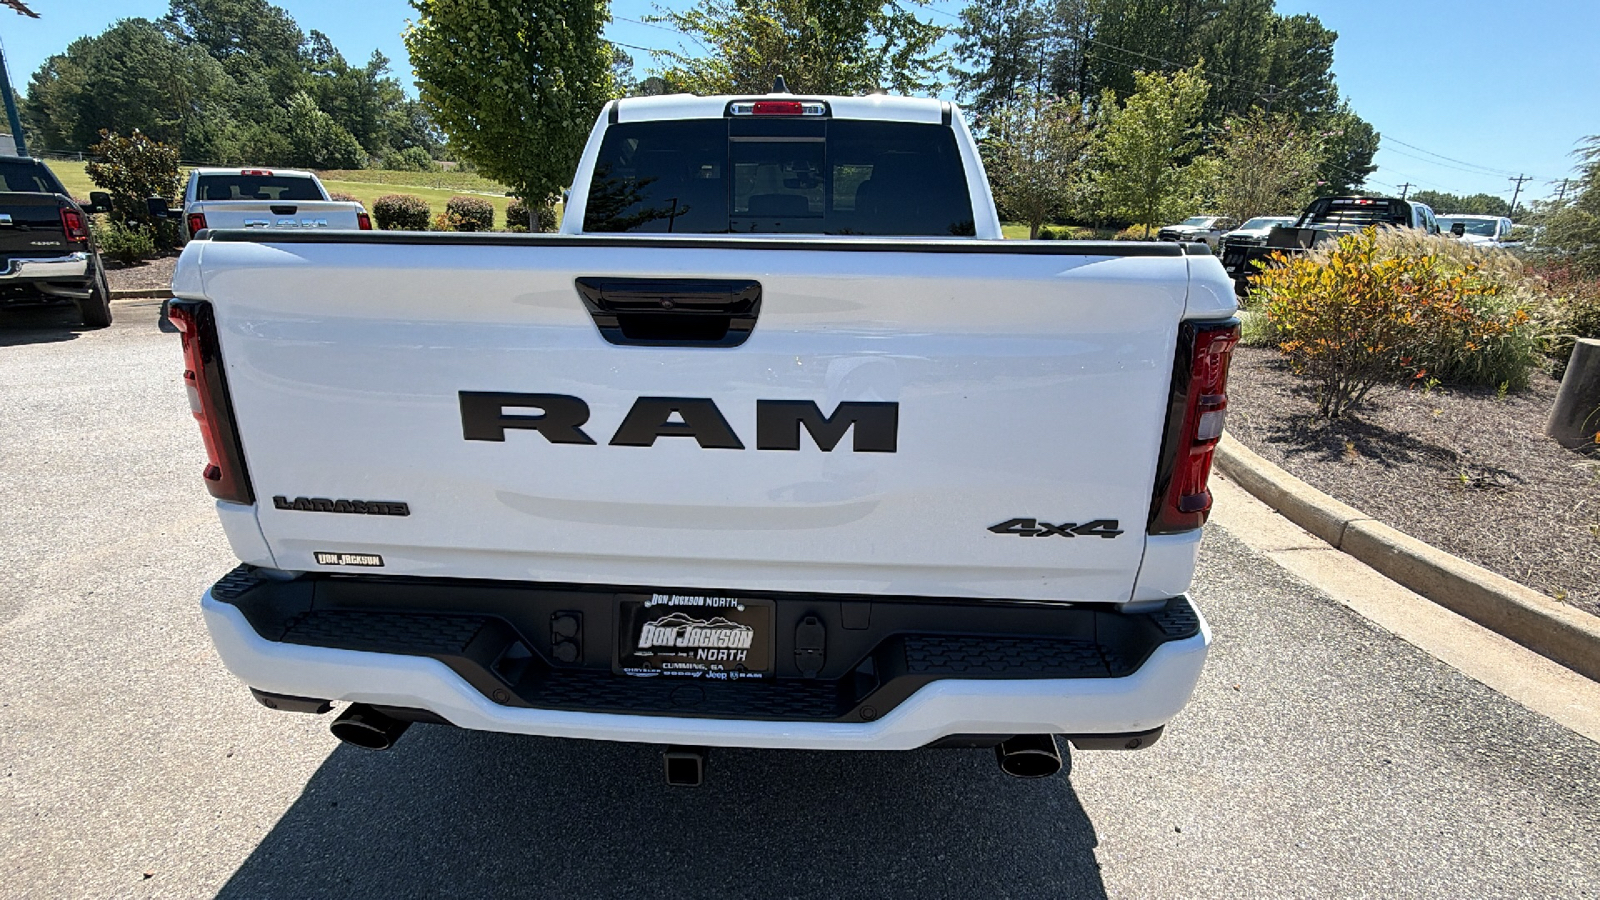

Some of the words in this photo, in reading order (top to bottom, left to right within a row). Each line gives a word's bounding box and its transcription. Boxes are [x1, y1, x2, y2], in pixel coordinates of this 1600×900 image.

[458, 390, 899, 453] RAM
[272, 496, 410, 516] LARAMIE
[986, 517, 1125, 539] 4x4
[705, 597, 738, 607] NORTH
[696, 648, 748, 661] NORTH
[705, 670, 728, 680] Jeep
